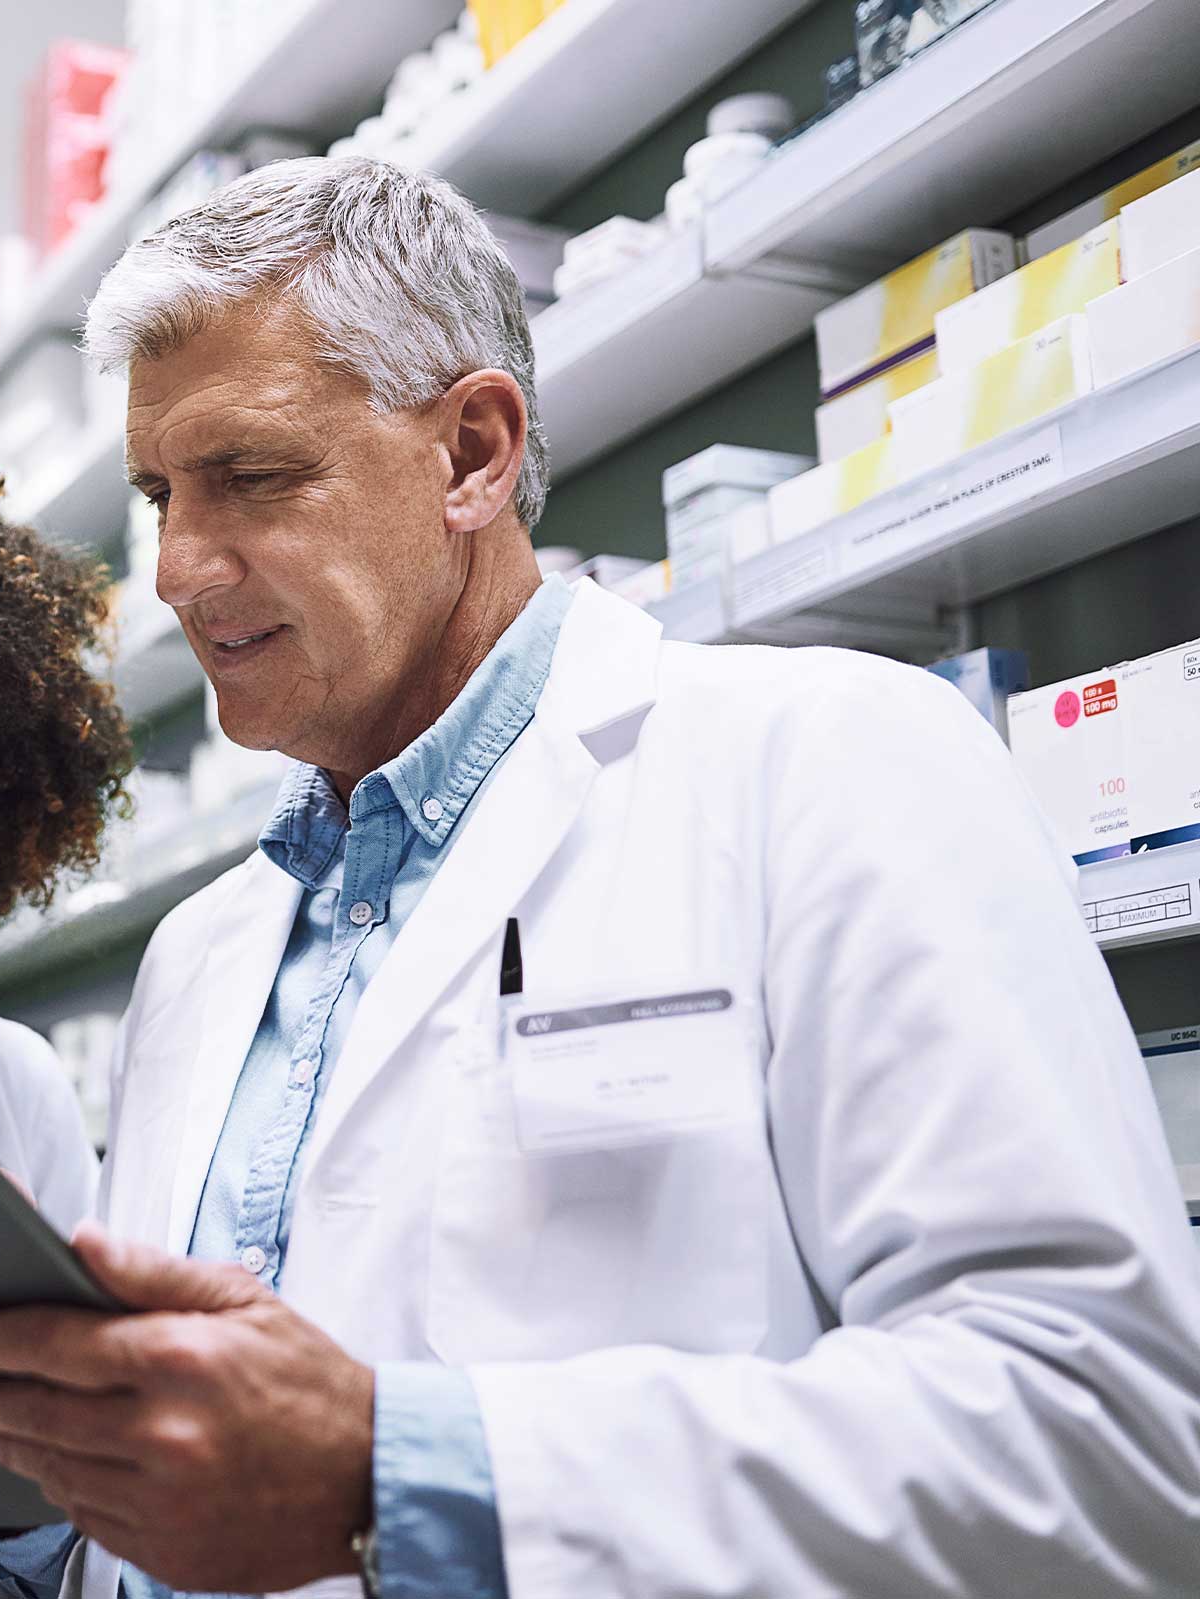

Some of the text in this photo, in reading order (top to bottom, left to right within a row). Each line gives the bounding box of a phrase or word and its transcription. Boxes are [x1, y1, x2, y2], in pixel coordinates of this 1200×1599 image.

[1084, 687, 1097, 699] 100
[1084, 700, 1101, 715] 100
[1101, 697, 1117, 712] mg
[1099, 776, 1125, 798] 100
[1089, 806, 1129, 823] antibiotic
[1094, 819, 1130, 835] capsules
[1121, 909, 1158, 923] MAXIMUM
